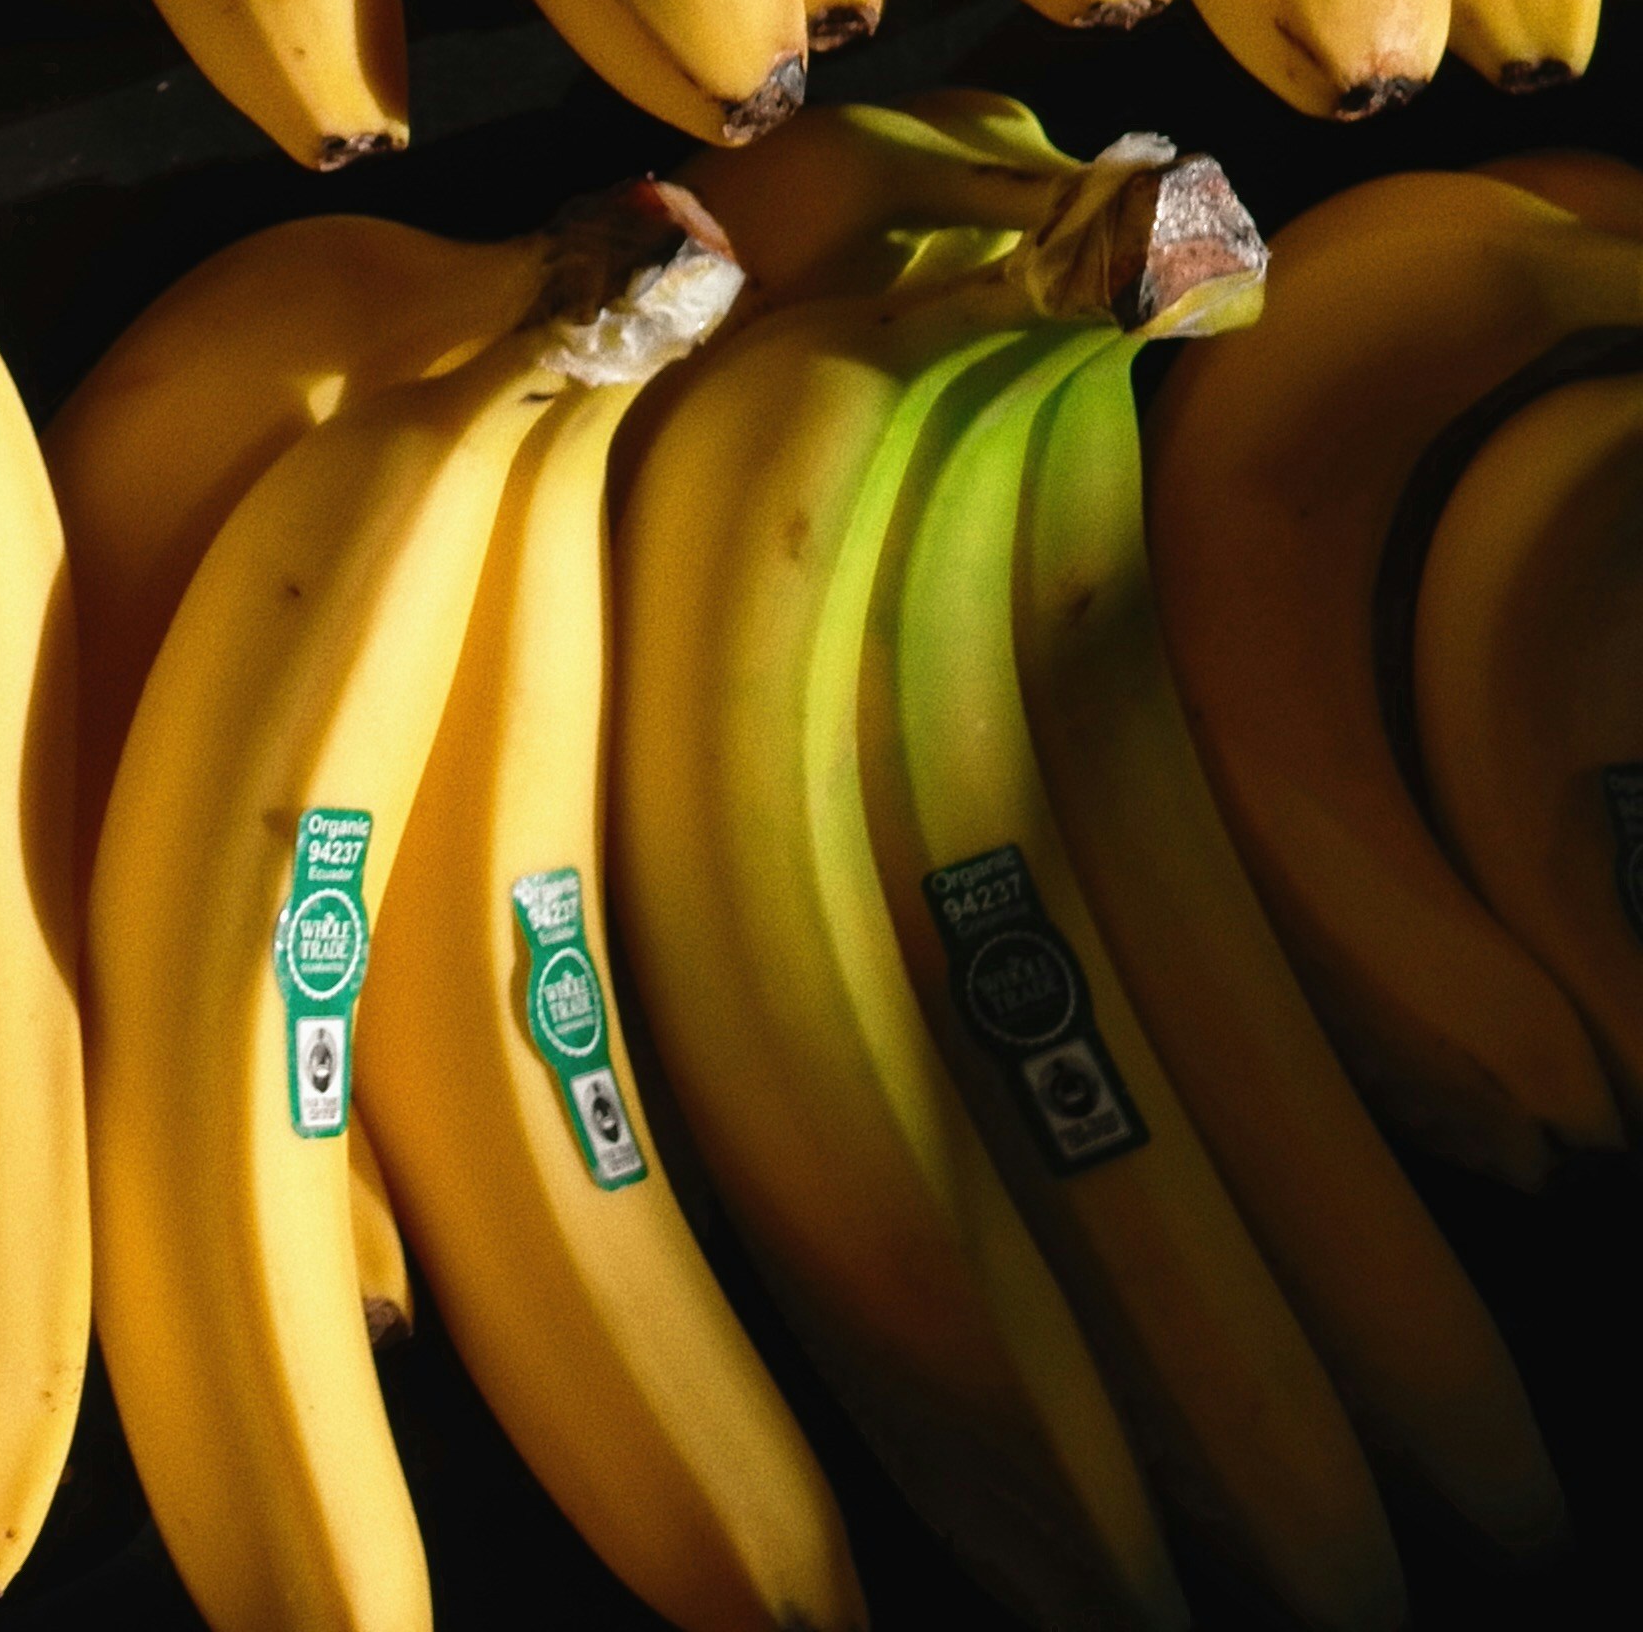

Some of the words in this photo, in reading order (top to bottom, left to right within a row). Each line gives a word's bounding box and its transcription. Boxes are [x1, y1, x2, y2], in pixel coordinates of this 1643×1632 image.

[308, 815, 370, 838] Organic
[308, 840, 363, 865] 94237
[942, 872, 1021, 922] 94237
[300, 917, 351, 940] WHOLE
[300, 939, 348, 960] TRADE
